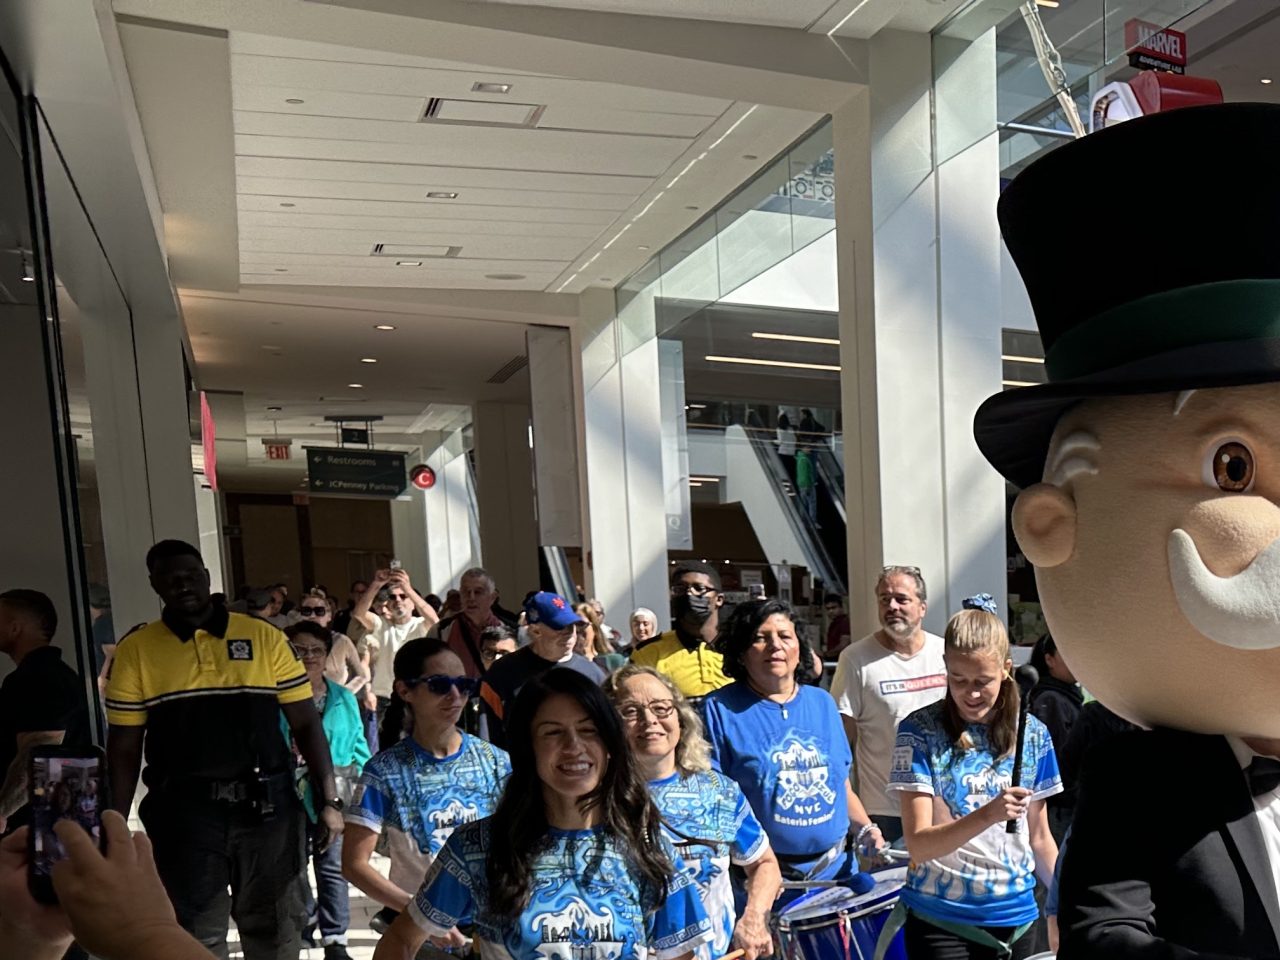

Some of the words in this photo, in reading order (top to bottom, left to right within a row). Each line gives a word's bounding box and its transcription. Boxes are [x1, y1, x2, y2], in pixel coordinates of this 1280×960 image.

[1138, 25, 1183, 58] MARVEL
[268, 445, 290, 460] EXIT
[327, 455, 377, 467] Restrooms
[328, 480, 368, 491] JCPenney
[794, 801, 822, 815] NYC
